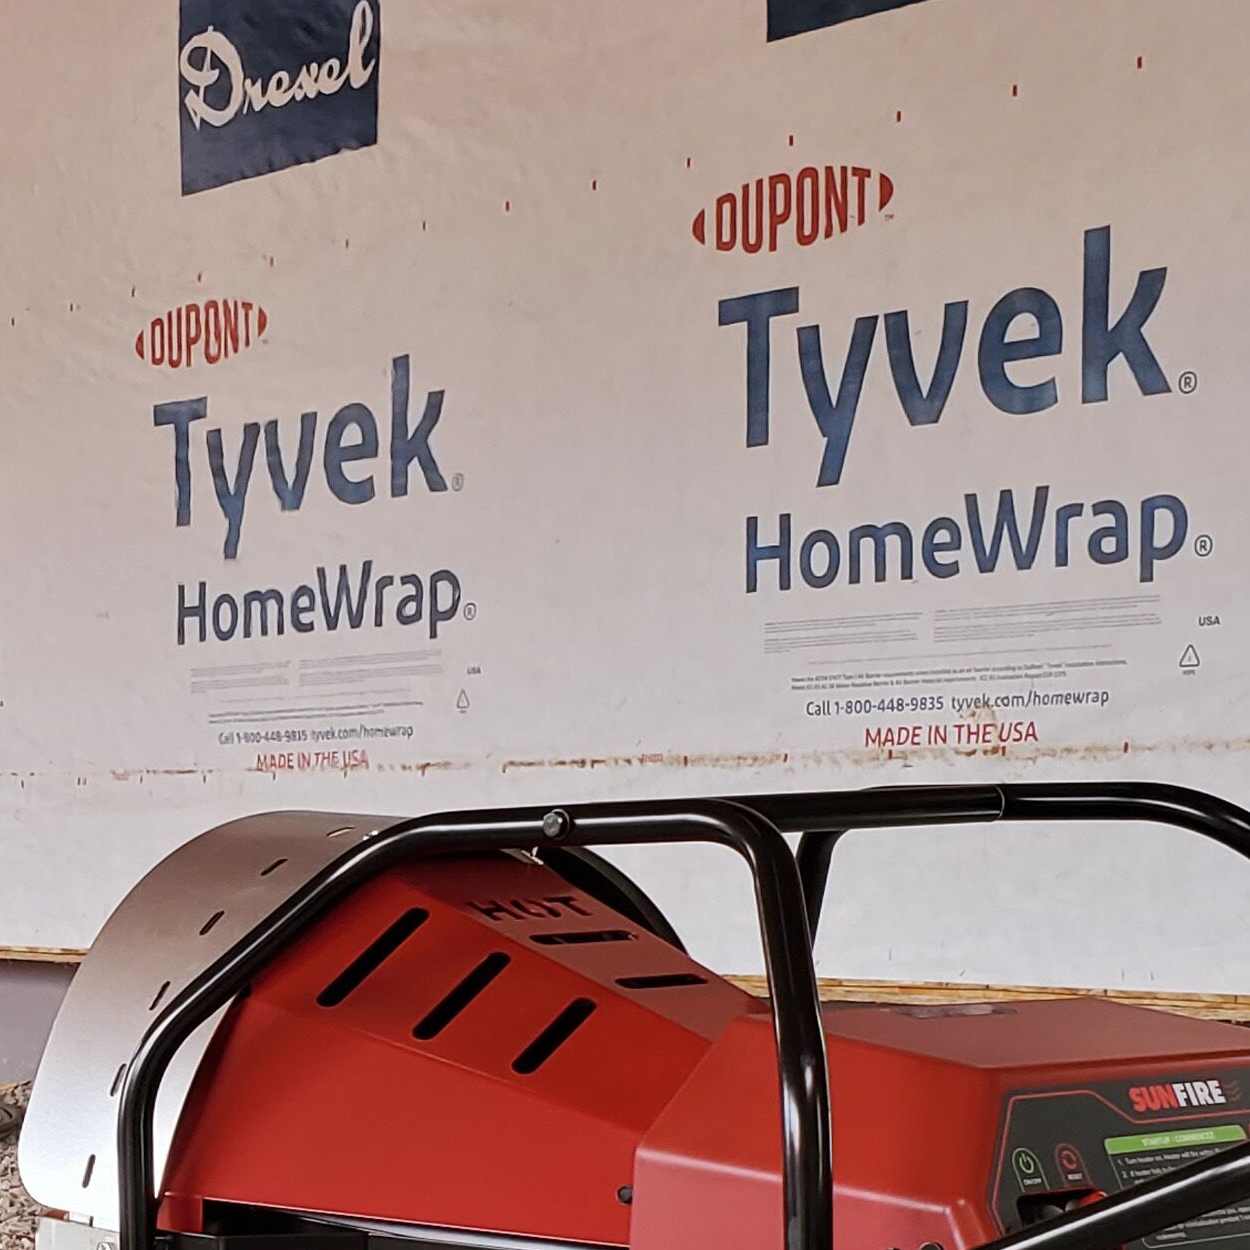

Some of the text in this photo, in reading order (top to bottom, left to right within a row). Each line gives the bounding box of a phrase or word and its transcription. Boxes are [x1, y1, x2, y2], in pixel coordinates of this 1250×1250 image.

[180, 0, 375, 129] Drexel
[716, 166, 871, 253] DUPONT
[151, 300, 253, 368] DUPONT
[1198, 616, 1220, 626] USA
[806, 690, 1110, 717] Call 1-800-448-9835 tyvek.com/homewrap
[864, 721, 1039, 748] MADE IN THE USA
[256, 750, 369, 770] MADE IN THE USA
[466, 896, 593, 921] HOT
[1129, 1080, 1227, 1112] SUNFIRE
